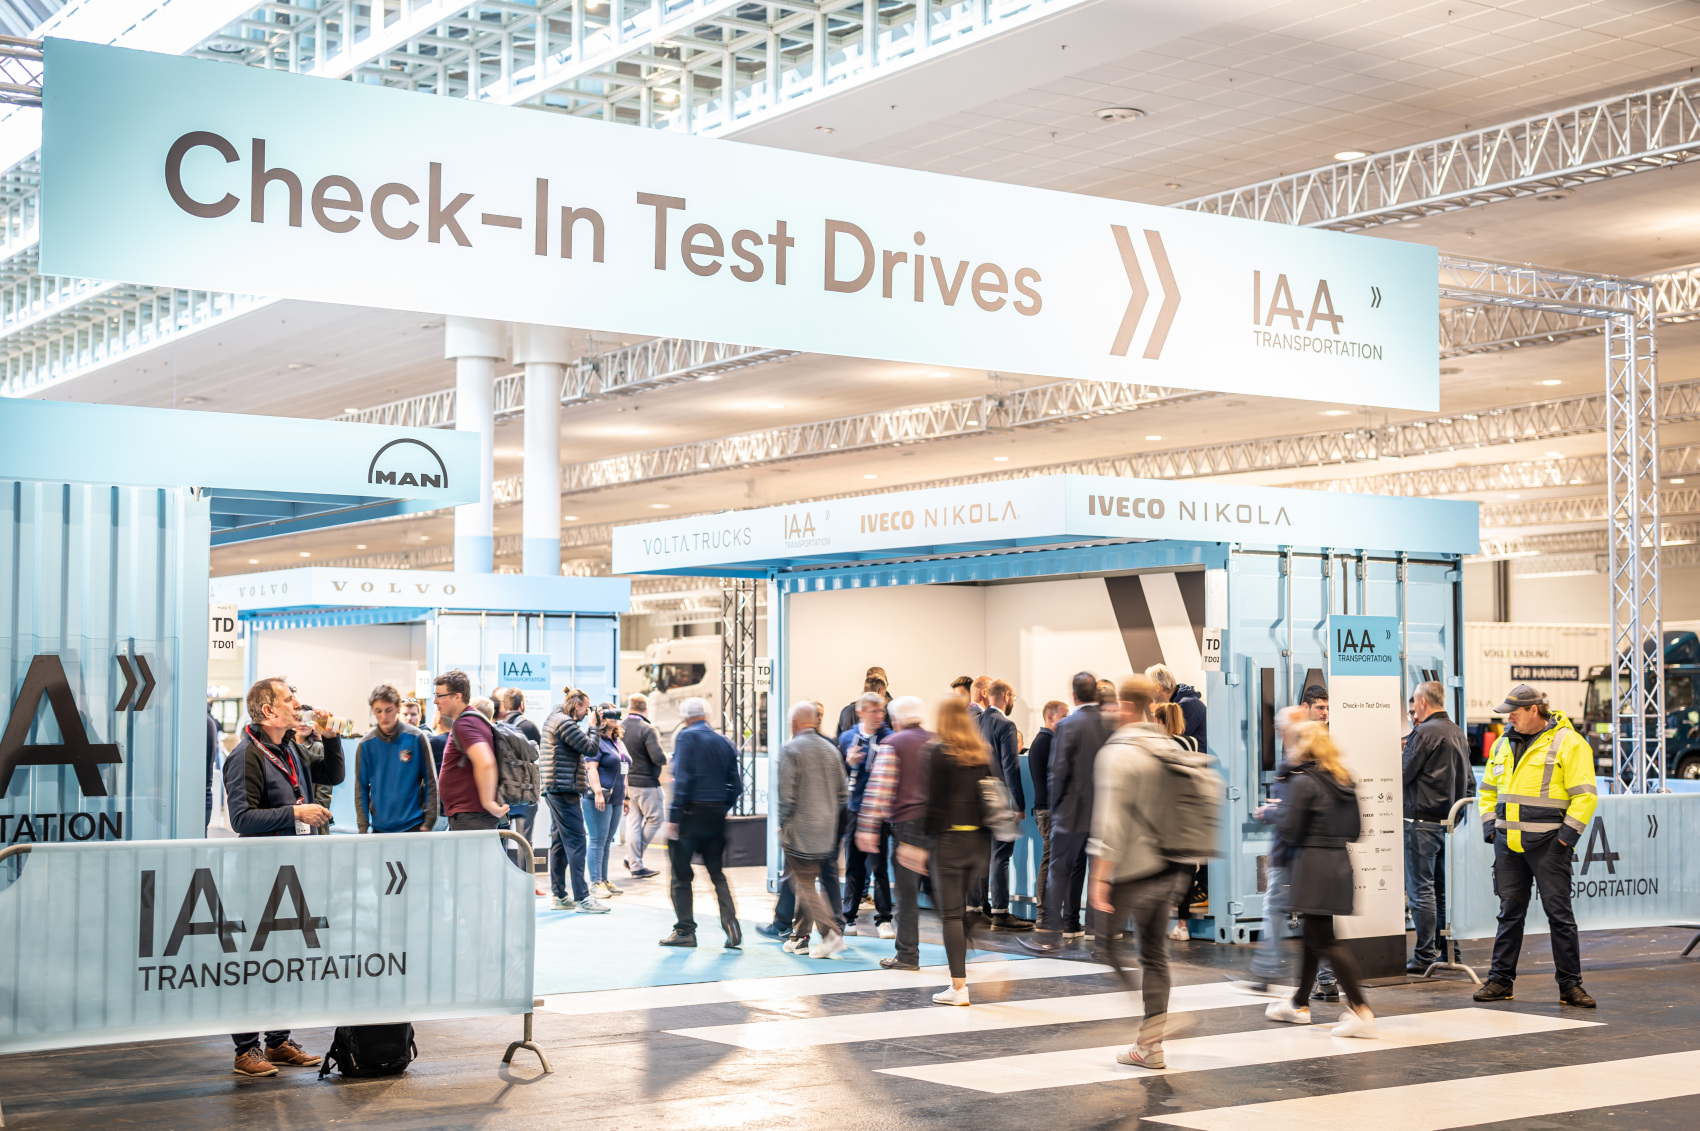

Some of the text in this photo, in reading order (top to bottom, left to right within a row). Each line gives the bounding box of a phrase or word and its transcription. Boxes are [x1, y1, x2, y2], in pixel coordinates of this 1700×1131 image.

[164, 130, 1043, 317] Check-In Test Drives
[1253, 269, 1345, 335] IAA
[1253, 330, 1383, 361] TRANSPORTATION
[375, 470, 441, 488] MAN
[860, 500, 1018, 534] IVECO NIKOLA
[1088, 494, 1292, 526] IVECO NIKOLA
[784, 511, 816, 540] IAA
[784, 537, 831, 549] TRANSPORTATION
[239, 583, 288, 598] VOLVO
[331, 580, 456, 595] VOLVO
[212, 617, 235, 633] TD
[212, 640, 234, 649] TD01
[1205, 638, 1221, 650] TD
[1337, 629, 1375, 653] IAA
[1204, 655, 1220, 663] TD02
[1338, 654, 1392, 662] TRANSPORTATION
[503, 661, 532, 677] IAA
[757, 666, 771, 675] TD
[1513, 667, 1531, 679] FÜR
[1532, 669, 1578, 680] HAMBURG
[138, 864, 330, 958] IAA
[138, 951, 407, 992] TRANSPORTATION
